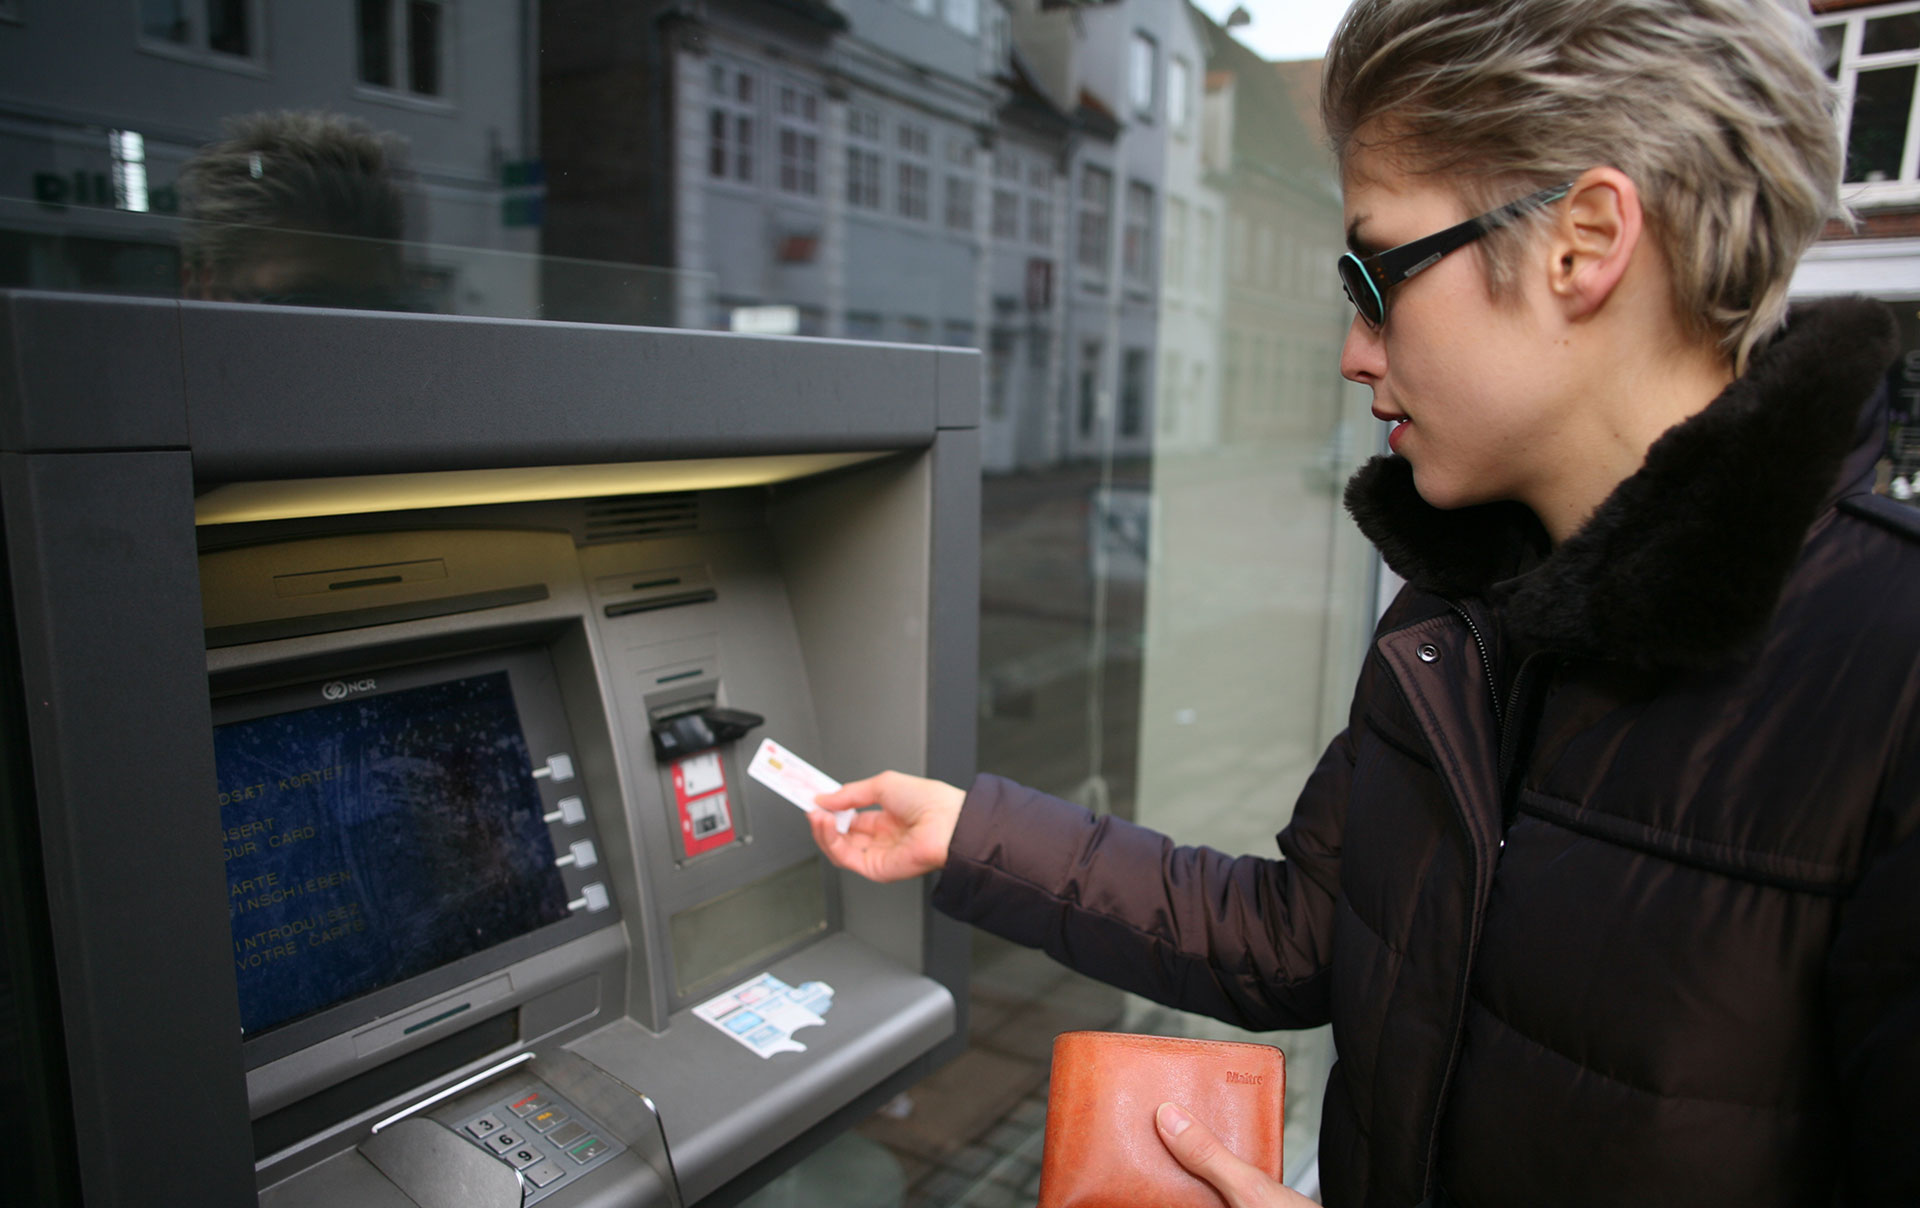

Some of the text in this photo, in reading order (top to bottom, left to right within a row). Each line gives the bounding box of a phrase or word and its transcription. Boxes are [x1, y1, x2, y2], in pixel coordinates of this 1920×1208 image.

[347, 679, 376, 693] NCR
[278, 765, 345, 792] KORTET
[268, 826, 316, 848] CARD
[231, 872, 280, 897] ARTE
[234, 903, 361, 953] INTRODUISEZ
[236, 920, 367, 972] VOTRE CARTE
[479, 1120, 494, 1131] 3
[499, 1134, 513, 1145] 6
[518, 1150, 532, 1161] 9
